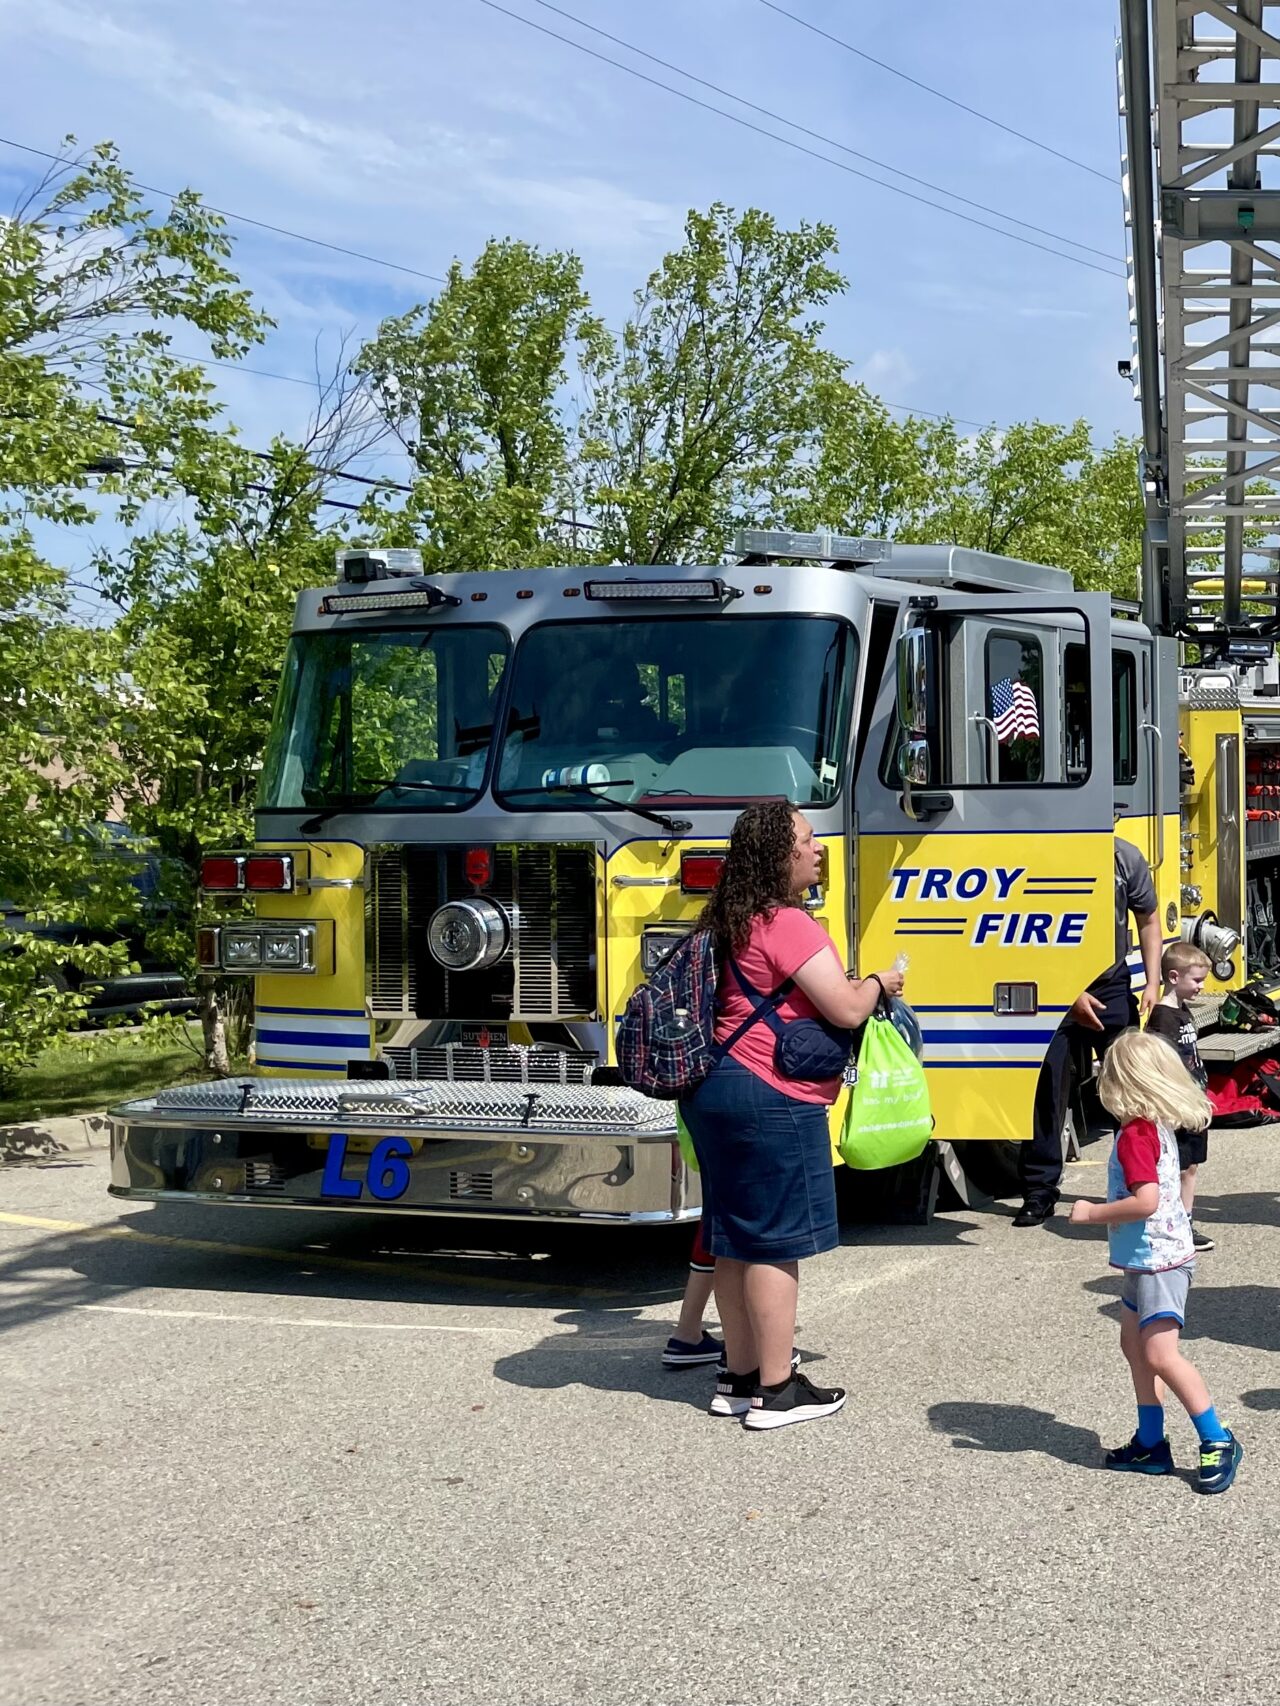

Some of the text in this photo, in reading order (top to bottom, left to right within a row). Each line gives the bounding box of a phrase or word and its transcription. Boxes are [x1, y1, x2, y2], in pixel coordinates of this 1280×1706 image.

[890, 867, 1026, 902] TROY
[971, 912, 1089, 947] FIRE
[321, 1133, 413, 1200] L6
